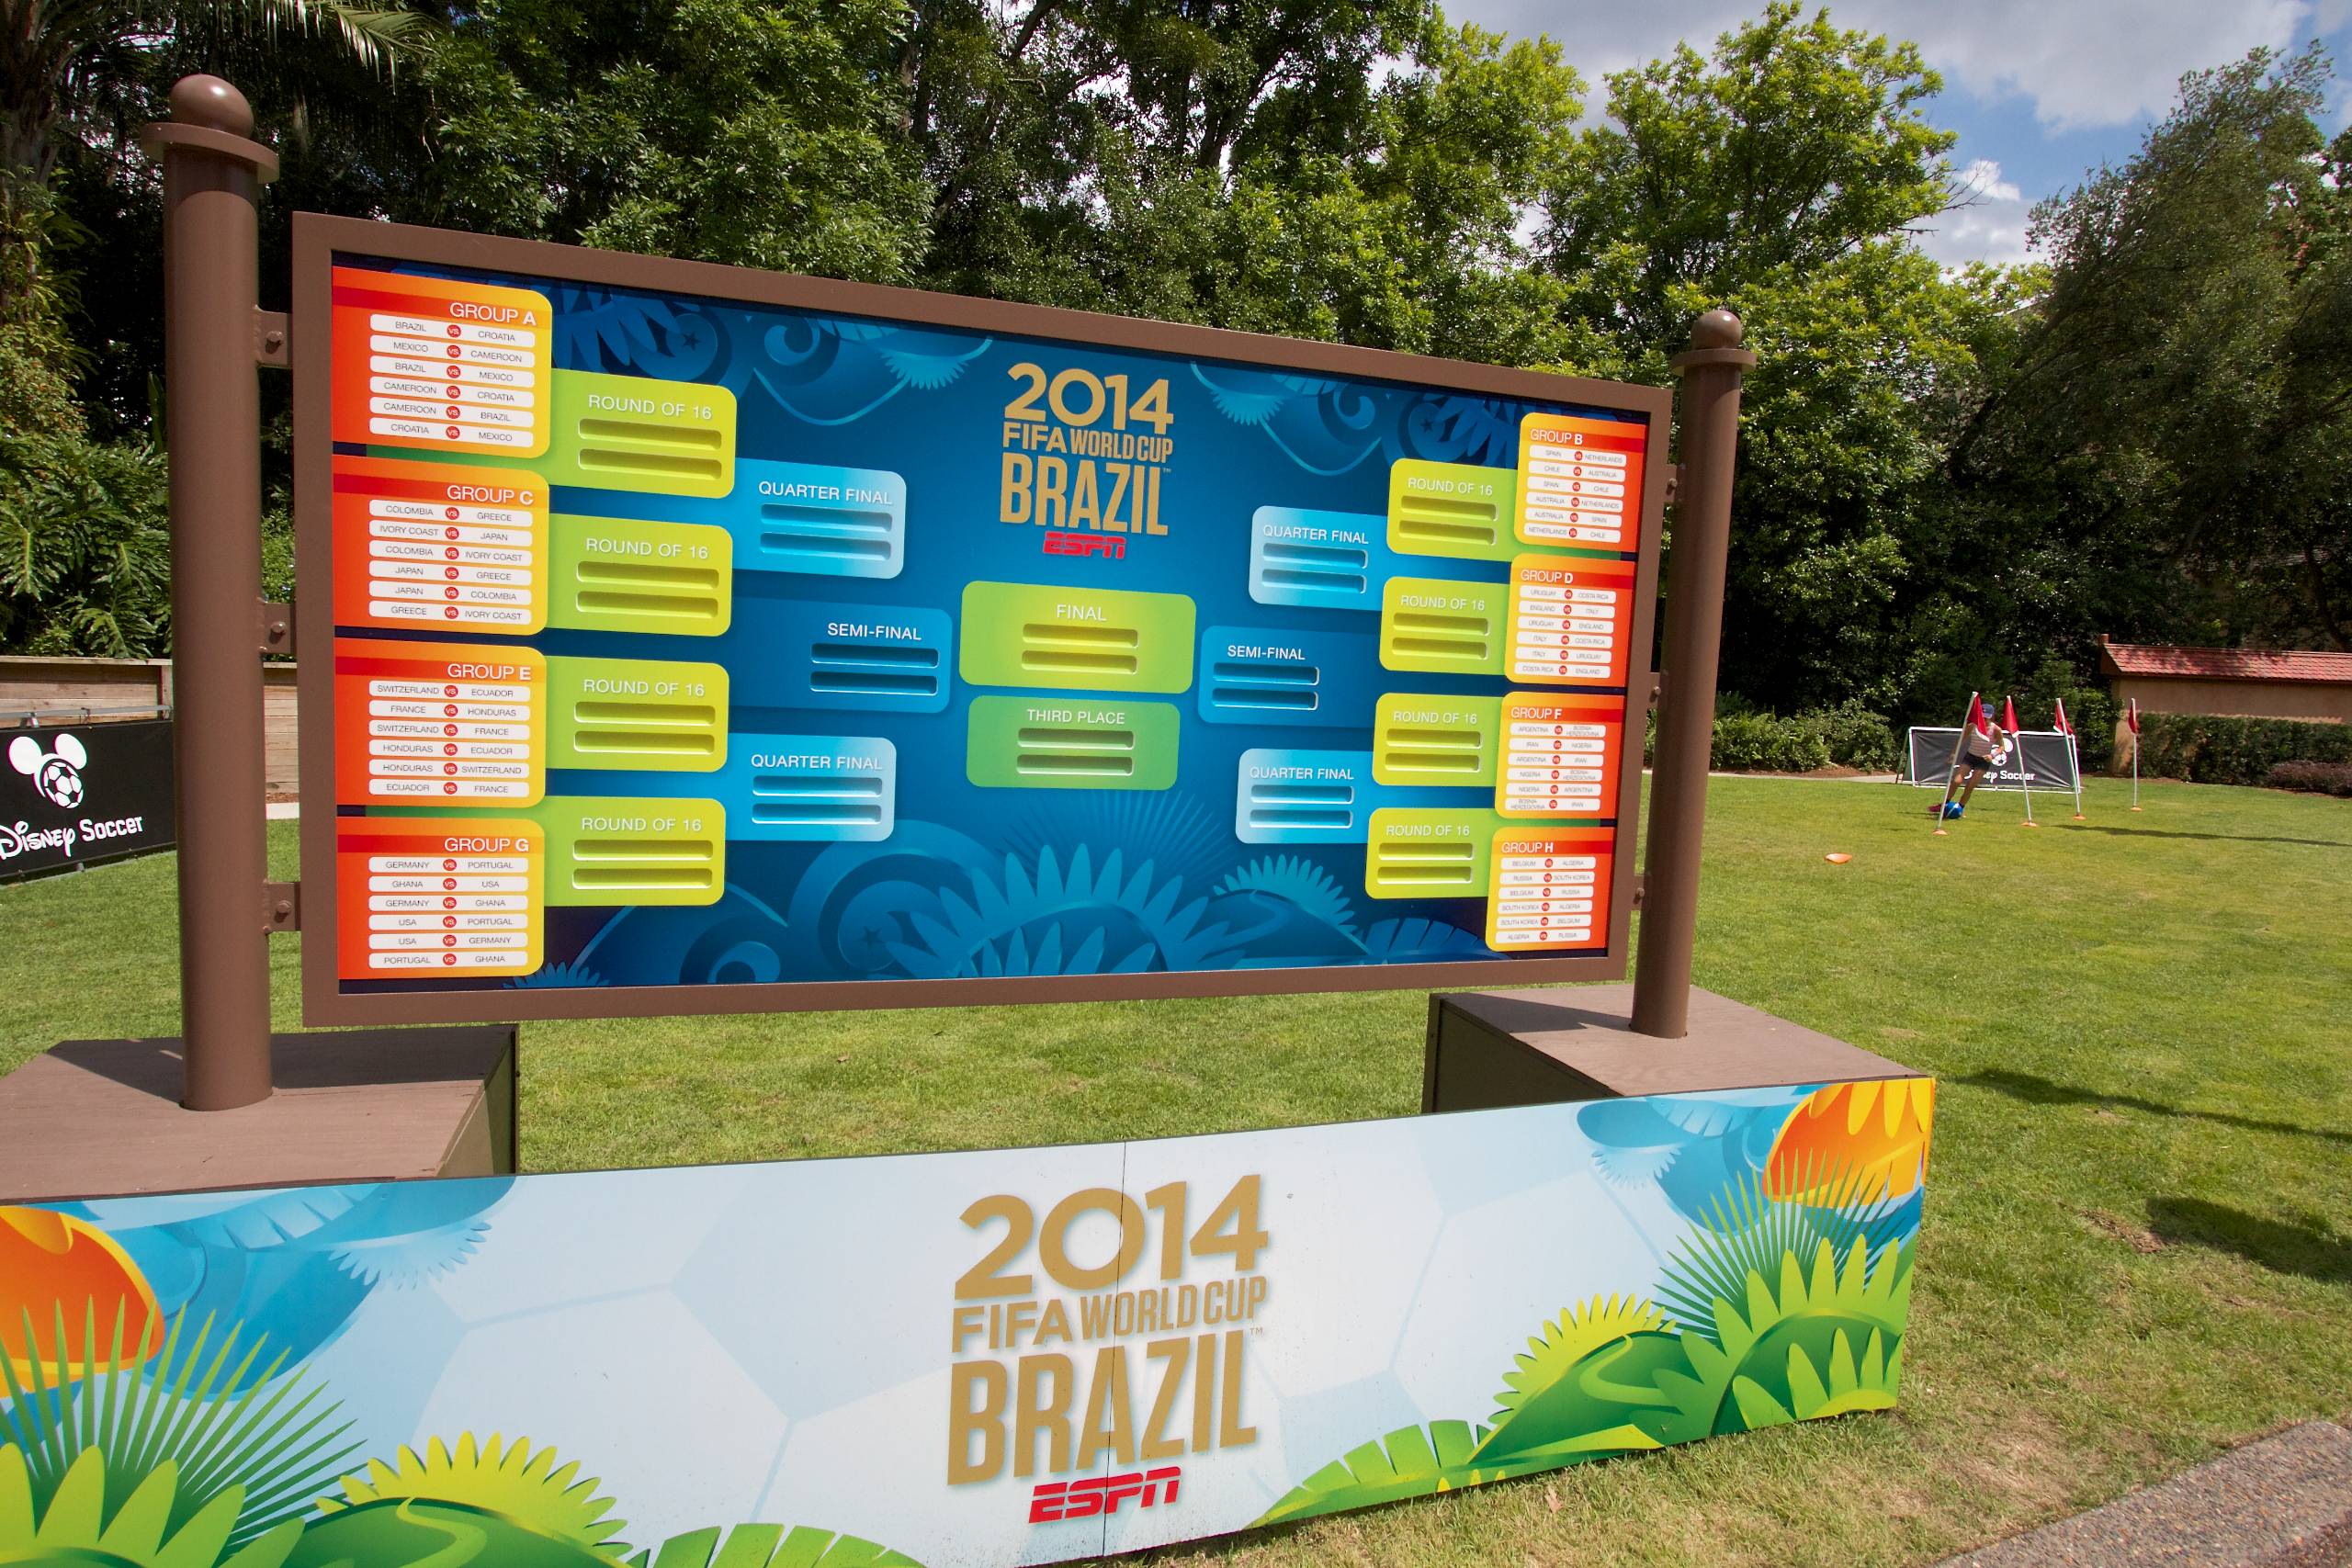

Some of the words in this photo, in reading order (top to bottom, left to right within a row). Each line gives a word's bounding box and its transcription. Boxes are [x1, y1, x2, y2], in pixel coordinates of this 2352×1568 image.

[449, 302, 518, 322] GROUP
[523, 310, 537, 326] A
[395, 321, 426, 332] BRAZIL
[478, 331, 515, 342] CROATIA
[393, 342, 428, 353] MEXICO
[470, 350, 522, 362] CAMEROON
[395, 362, 425, 373] BRAZIL
[480, 371, 514, 381] MEXICO
[384, 382, 436, 393] CAMEROON
[478, 391, 514, 401] CROATIA
[1005, 362, 1174, 434] 2014
[384, 402, 436, 414] CAMEROON
[481, 412, 510, 422] BRAZIL
[588, 395, 655, 415] ROUND
[662, 403, 684, 417] OF
[694, 405, 713, 420] 16
[391, 423, 429, 434] CROATIA
[479, 432, 513, 442] MEXICO
[1530, 429, 1572, 443] GROUP
[1575, 434, 1583, 445] B
[1003, 422, 1068, 453] FIFA
[1070, 428, 1135, 459] WORLD
[1136, 435, 1173, 463] CUP
[447, 485, 514, 503] GROUP
[519, 491, 534, 505] C
[759, 480, 841, 501] QUARTER
[845, 489, 893, 505] FINAL
[1000, 452, 1169, 536] BRAZIL
[1408, 477, 1453, 493] ROUND
[1458, 483, 1475, 494] OF
[1479, 484, 1493, 496] 16
[386, 505, 434, 515] COLOMBIA
[477, 512, 512, 522] GREECE
[380, 525, 406, 535] IVORY
[408, 526, 438, 536] COAST
[481, 533, 508, 541] JAPAN
[1263, 525, 1327, 541] QUARTER
[1331, 530, 1369, 544] FINAL
[586, 538, 651, 556] ROUND
[659, 545, 682, 558] OF
[690, 546, 708, 559] 16
[1043, 530, 1126, 559] ESPN
[386, 546, 433, 556] COLOMBIA
[466, 551, 492, 560] IVORY
[493, 553, 522, 562] COAST
[395, 566, 423, 575] JAPAN
[477, 571, 511, 581] GREECE
[1521, 570, 1562, 582] GROUP
[1565, 573, 1573, 583] D
[395, 586, 423, 595] JAPAN
[470, 591, 516, 601] COLOMBIA
[1401, 594, 1446, 609] ROUND
[1450, 598, 1466, 610] OF
[1472, 600, 1485, 611] 16
[391, 606, 426, 615] GREECE
[465, 611, 491, 619] IVORY
[492, 611, 522, 620] COAST
[1057, 604, 1108, 622] FINAL
[827, 623, 922, 641] SEMI-FINAL
[1227, 646, 1306, 660] SEMI-FINAL
[447, 663, 514, 680] GROUP
[519, 666, 532, 681] E
[377, 685, 439, 694] SWITZERLAND
[471, 689, 514, 697] ECUADOR
[583, 679, 649, 694] ROUND
[655, 682, 679, 695] OF
[686, 683, 706, 697] 16
[390, 705, 426, 714] FRANCE
[468, 707, 516, 716] HONDURAS
[1027, 708, 1072, 722] THIRD
[1078, 711, 1125, 725] PLACE
[1393, 711, 1439, 723] ROUND
[1442, 713, 1459, 724] OF
[1464, 713, 1477, 725] 16
[1510, 707, 1552, 719] GROUP
[1555, 709, 1562, 719] F
[377, 724, 439, 733] SWITZERLAND
[475, 728, 509, 736] FRANCE
[383, 744, 433, 752] HONDURAS
[470, 747, 513, 755] ECUADOR
[383, 763, 433, 772] HONDURAS
[462, 765, 522, 774] SWITZERLAND
[751, 753, 831, 769] QUARTER
[837, 757, 883, 771] FINAL
[1250, 767, 1313, 780] QUARTER
[1317, 768, 1354, 780] FINAL
[387, 784, 429, 792] ECUADOR
[474, 784, 508, 793] FRANCE
[79, 817, 142, 841] Soccer
[582, 818, 647, 831] ROUND
[653, 818, 676, 831] OF
[684, 819, 702, 831] 16
[1386, 826, 1431, 836] ROUND
[1435, 826, 1452, 836] OF
[1457, 826, 1470, 836] 16
[444, 838, 510, 852] GROUP
[514, 839, 529, 852] G
[1501, 842, 1542, 852] GROUP
[1545, 842, 1554, 852] H
[386, 861, 429, 869] GERMANY
[468, 861, 514, 869] PORTUGAL
[392, 880, 423, 888] GHANA
[481, 880, 499, 888] USA
[386, 899, 429, 908] GERMANY
[475, 898, 505, 907] GHANA
[468, 918, 513, 926] PORTUGAL
[399, 937, 416, 945] USA
[469, 936, 511, 944] GERMANY
[384, 956, 431, 964] PORTUGAL
[954, 1174, 1269, 1301] 2014
[952, 1299, 1073, 1353] FIFA
[1080, 1284, 1197, 1340] WORLD
[1203, 1276, 1267, 1325] CUP
[947, 1329, 1257, 1485] BRAZIL
[1028, 1466, 1182, 1524] ESPN
